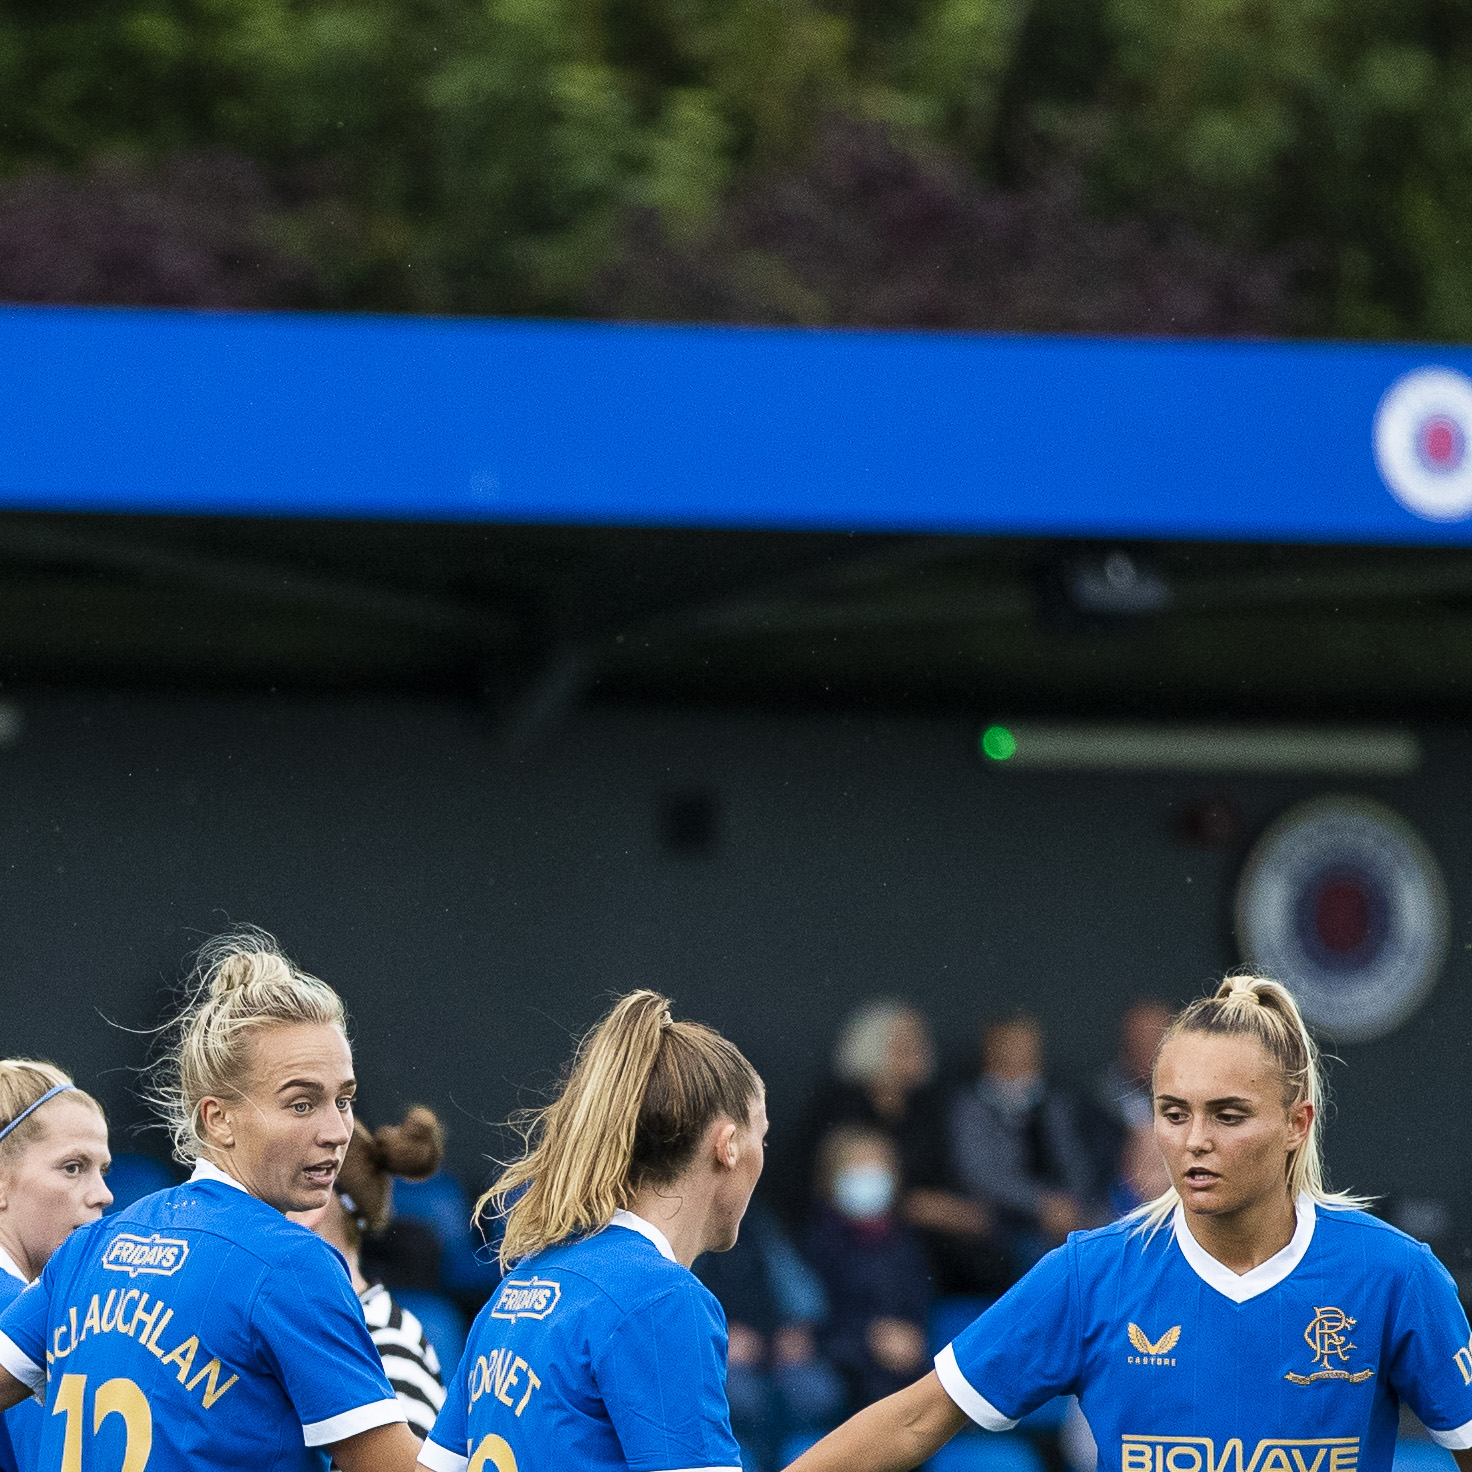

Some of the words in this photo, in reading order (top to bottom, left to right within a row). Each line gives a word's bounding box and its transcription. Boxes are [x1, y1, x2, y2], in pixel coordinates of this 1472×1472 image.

[110, 1241, 178, 1269] FRIDAYS
[46, 1289, 240, 1411] CLAUCHLAN
[467, 1348, 542, 1418] ORNET
